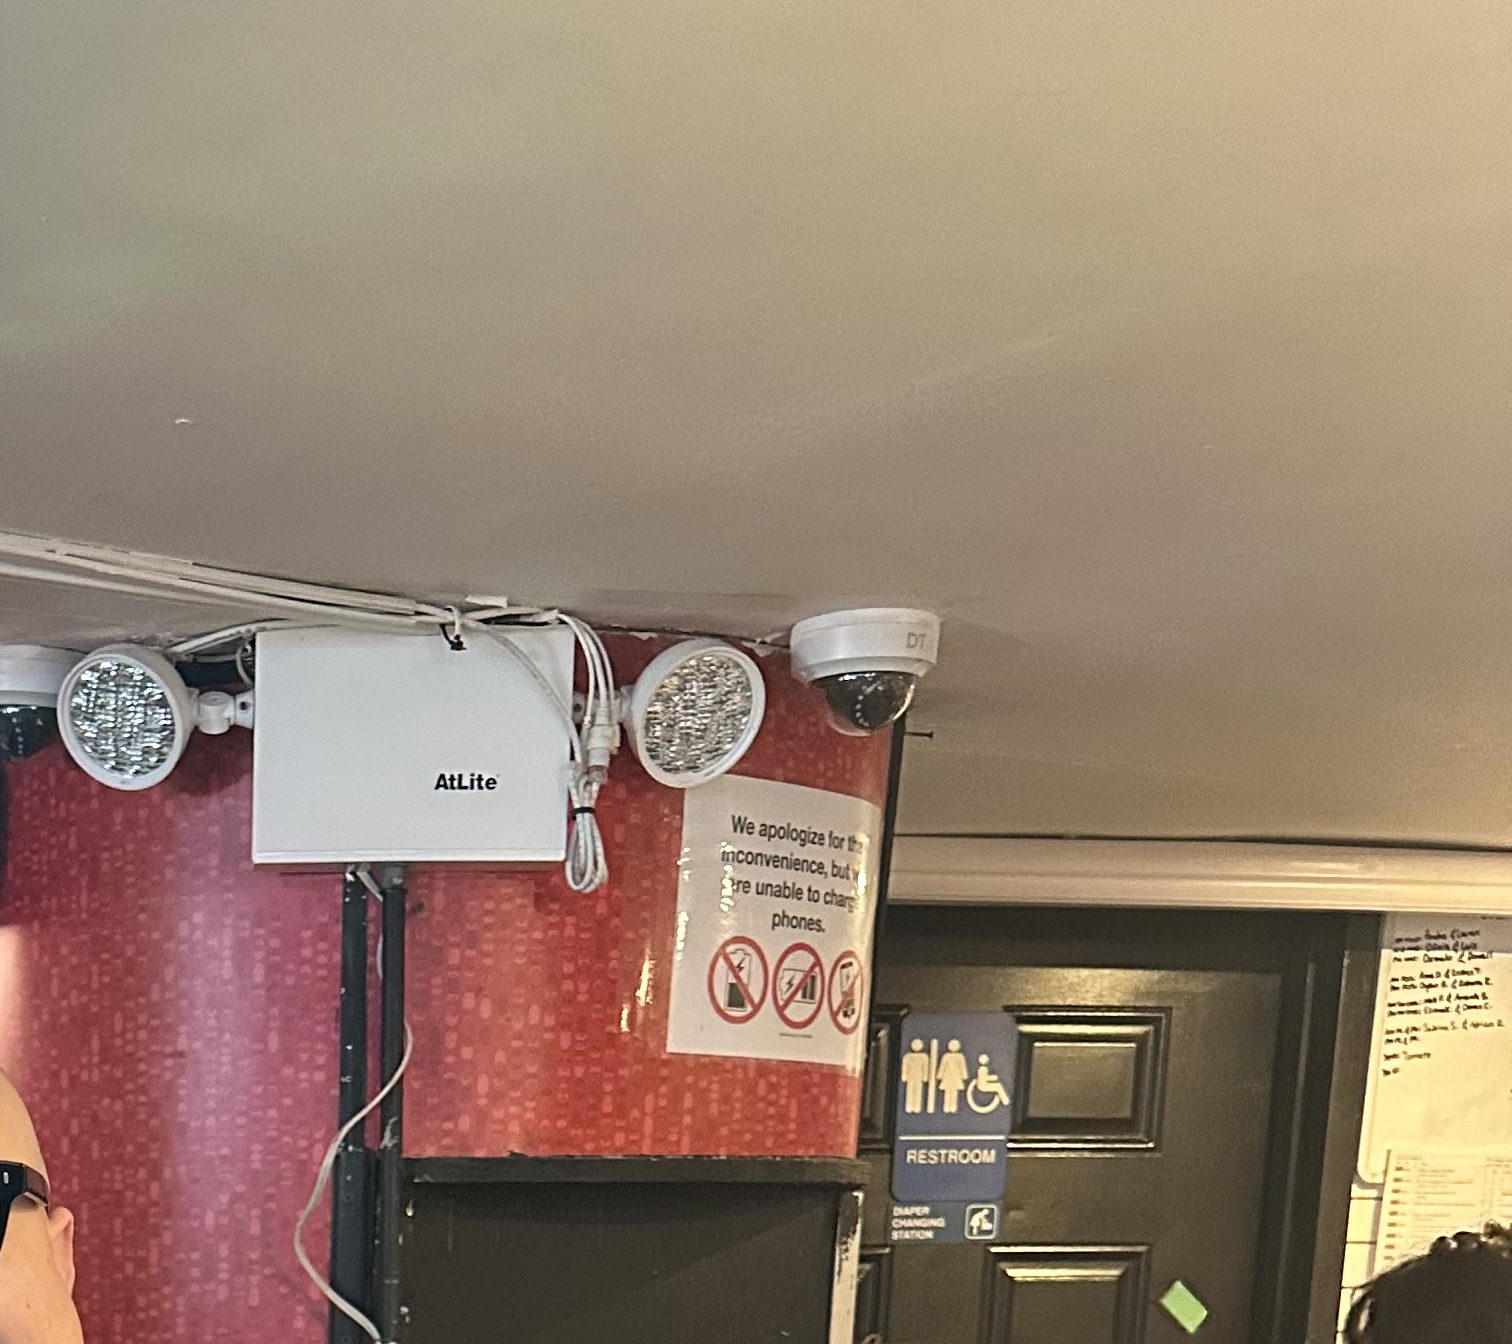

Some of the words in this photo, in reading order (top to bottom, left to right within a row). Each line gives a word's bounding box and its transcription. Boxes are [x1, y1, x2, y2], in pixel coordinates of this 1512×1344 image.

[434, 772, 498, 791] AtLite
[731, 814, 755, 835] We
[759, 822, 825, 847] apologize
[828, 830, 845, 850] for
[721, 848, 828, 879] inconvenience,
[831, 860, 851, 881] but
[755, 881, 804, 901] unable
[807, 885, 820, 902] to
[823, 888, 859, 913] charg
[771, 909, 826, 933] phones.
[905, 1148, 997, 1164] RESTROOM
[892, 1206, 930, 1217] DIAPER
[891, 1217, 946, 1229] CHANGING
[891, 1229, 934, 1240] STATION
